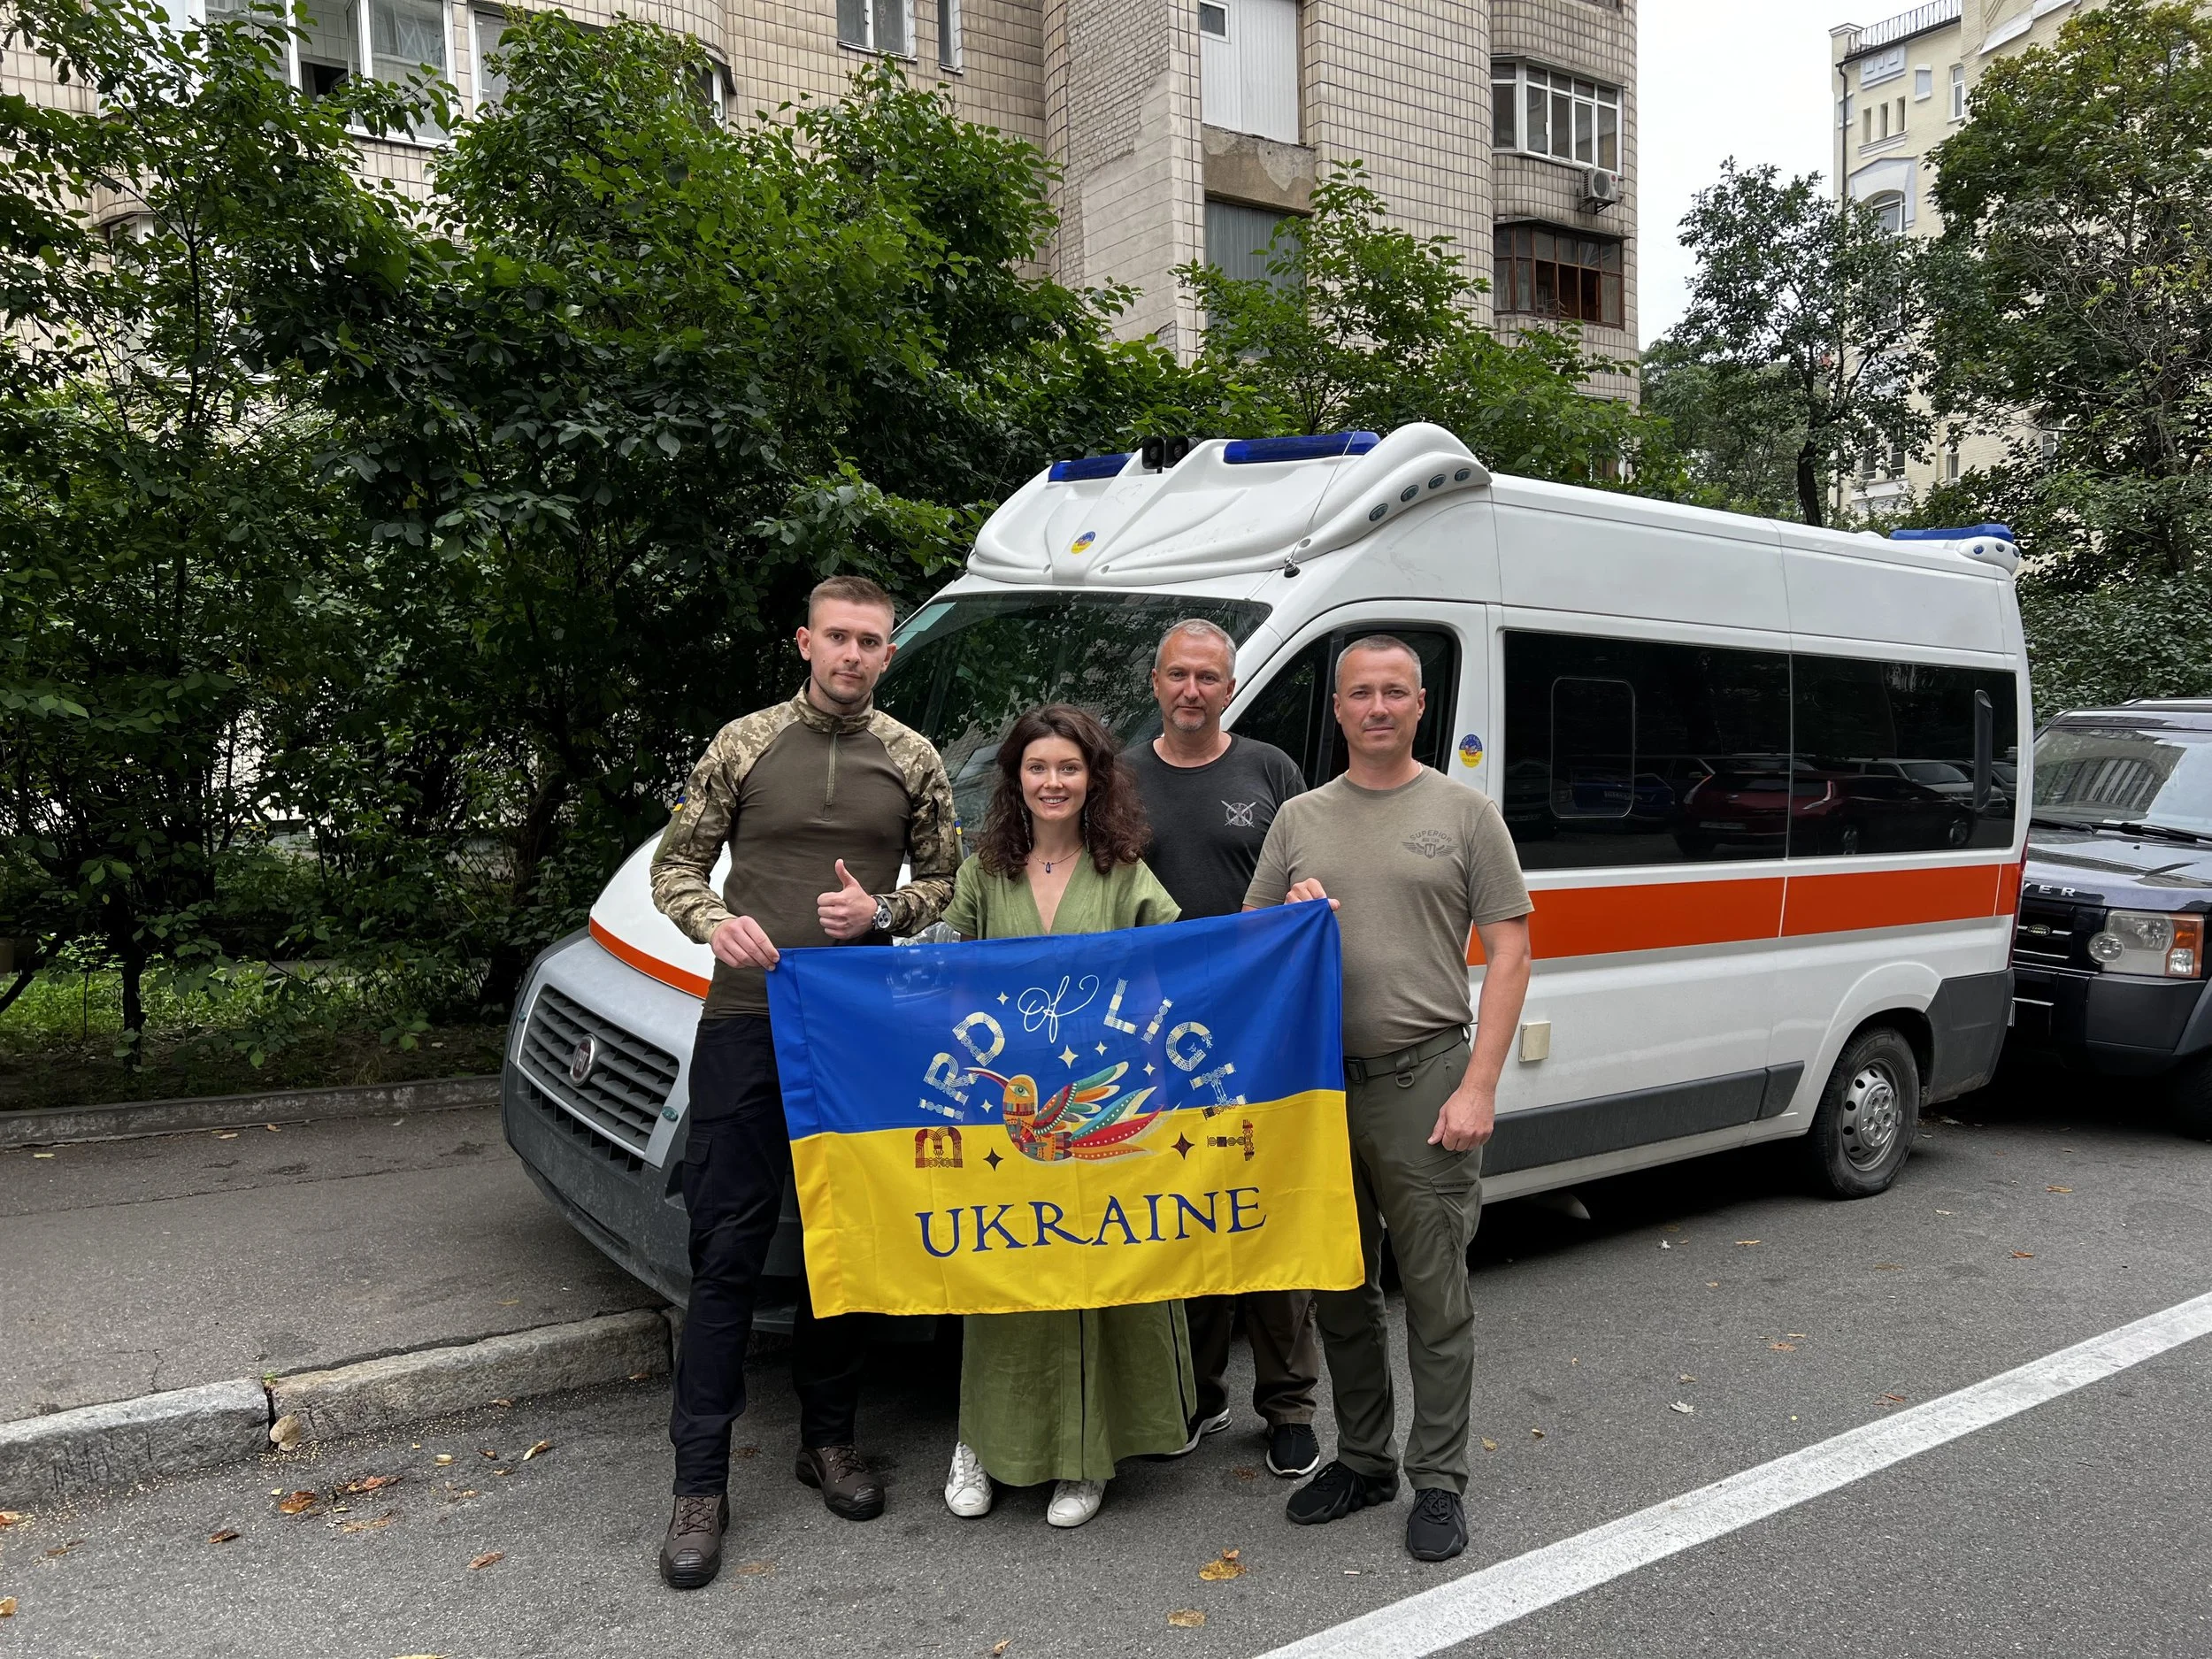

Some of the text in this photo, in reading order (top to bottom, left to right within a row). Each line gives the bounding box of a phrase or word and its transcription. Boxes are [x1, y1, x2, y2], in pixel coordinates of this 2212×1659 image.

[1409, 829, 1453, 843] SUPERIOR
[914, 1011, 1005, 1169] BIRD
[1102, 978, 1255, 1161] LIGHT
[914, 1187, 1267, 1258] UKRAINE
